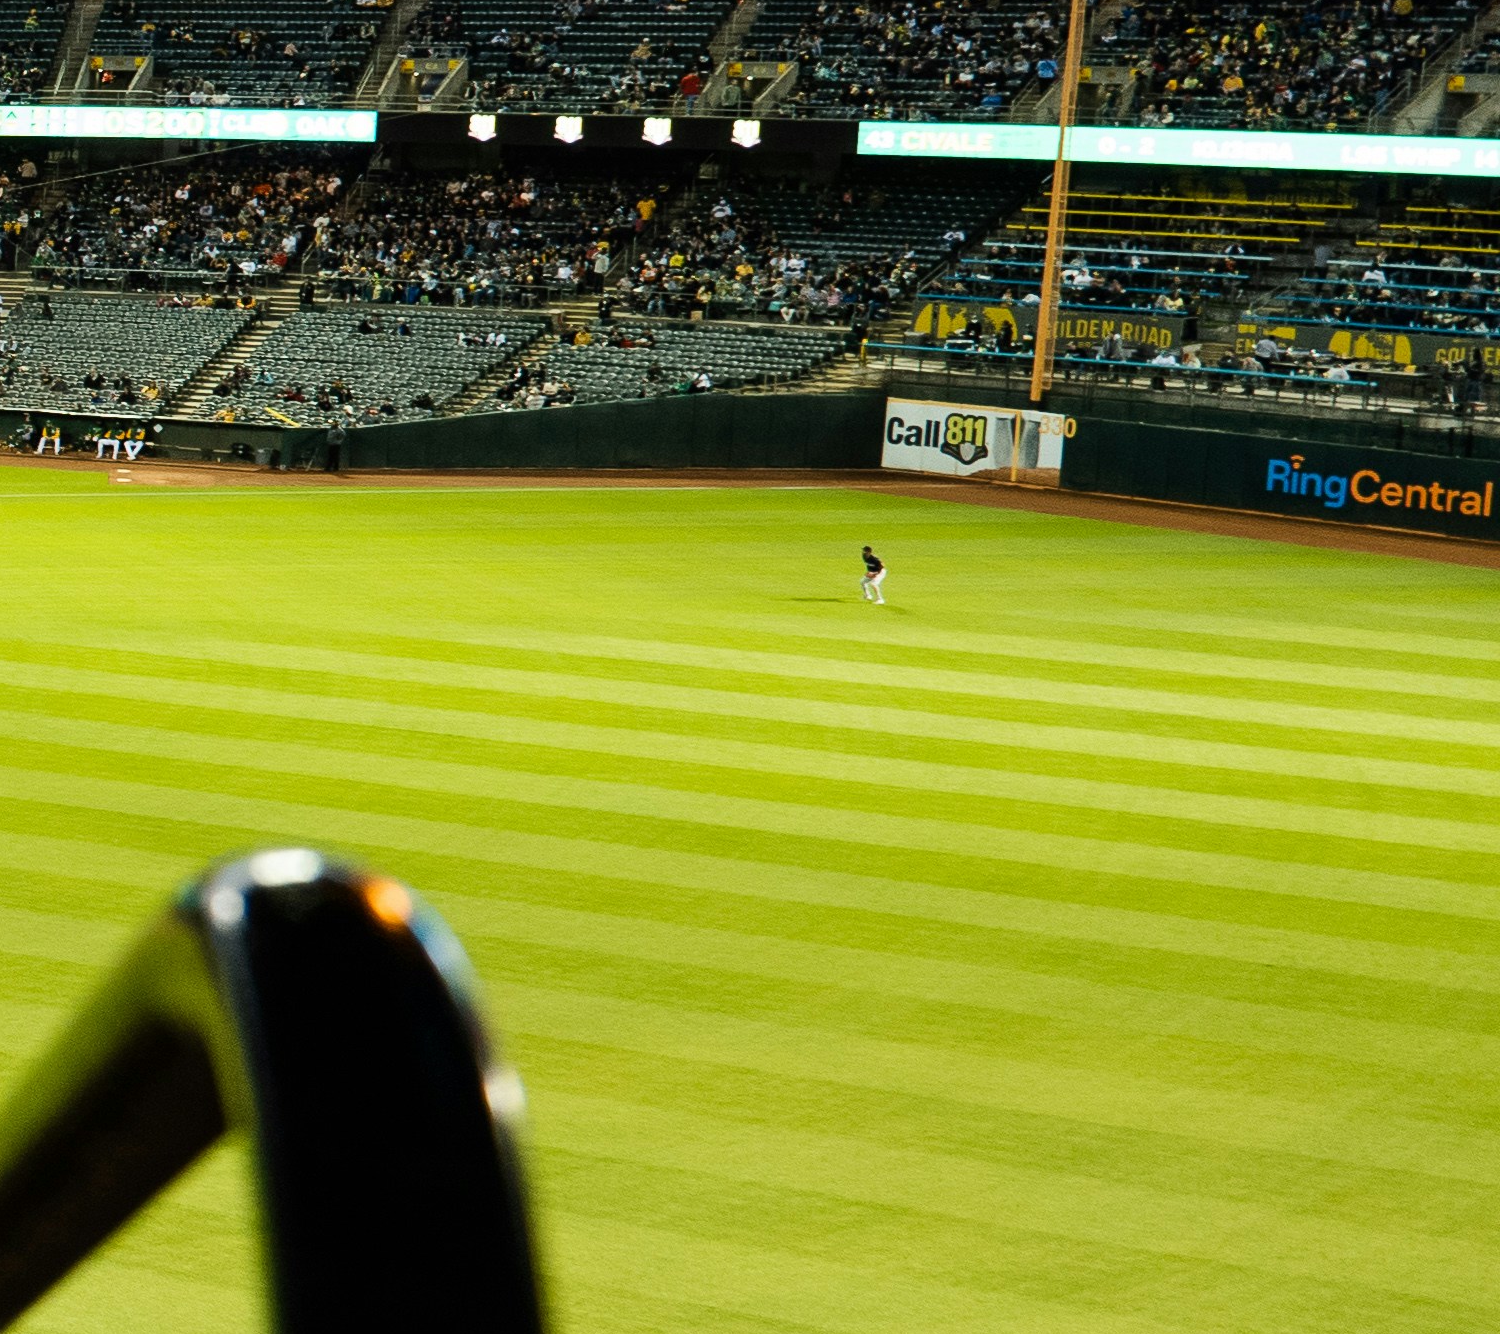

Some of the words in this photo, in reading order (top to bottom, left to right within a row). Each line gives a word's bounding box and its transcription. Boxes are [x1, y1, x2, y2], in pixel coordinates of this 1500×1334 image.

[900, 130, 995, 152] CIVALE
[1138, 135, 1156, 156] 2
[1047, 318, 1115, 340] OLDEN
[1121, 322, 1173, 349] ROAD
[886, 416, 940, 450] Call
[945, 413, 986, 447] 811
[1038, 415, 1077, 439] 330
[1265, 455, 1494, 517] RingCentral
